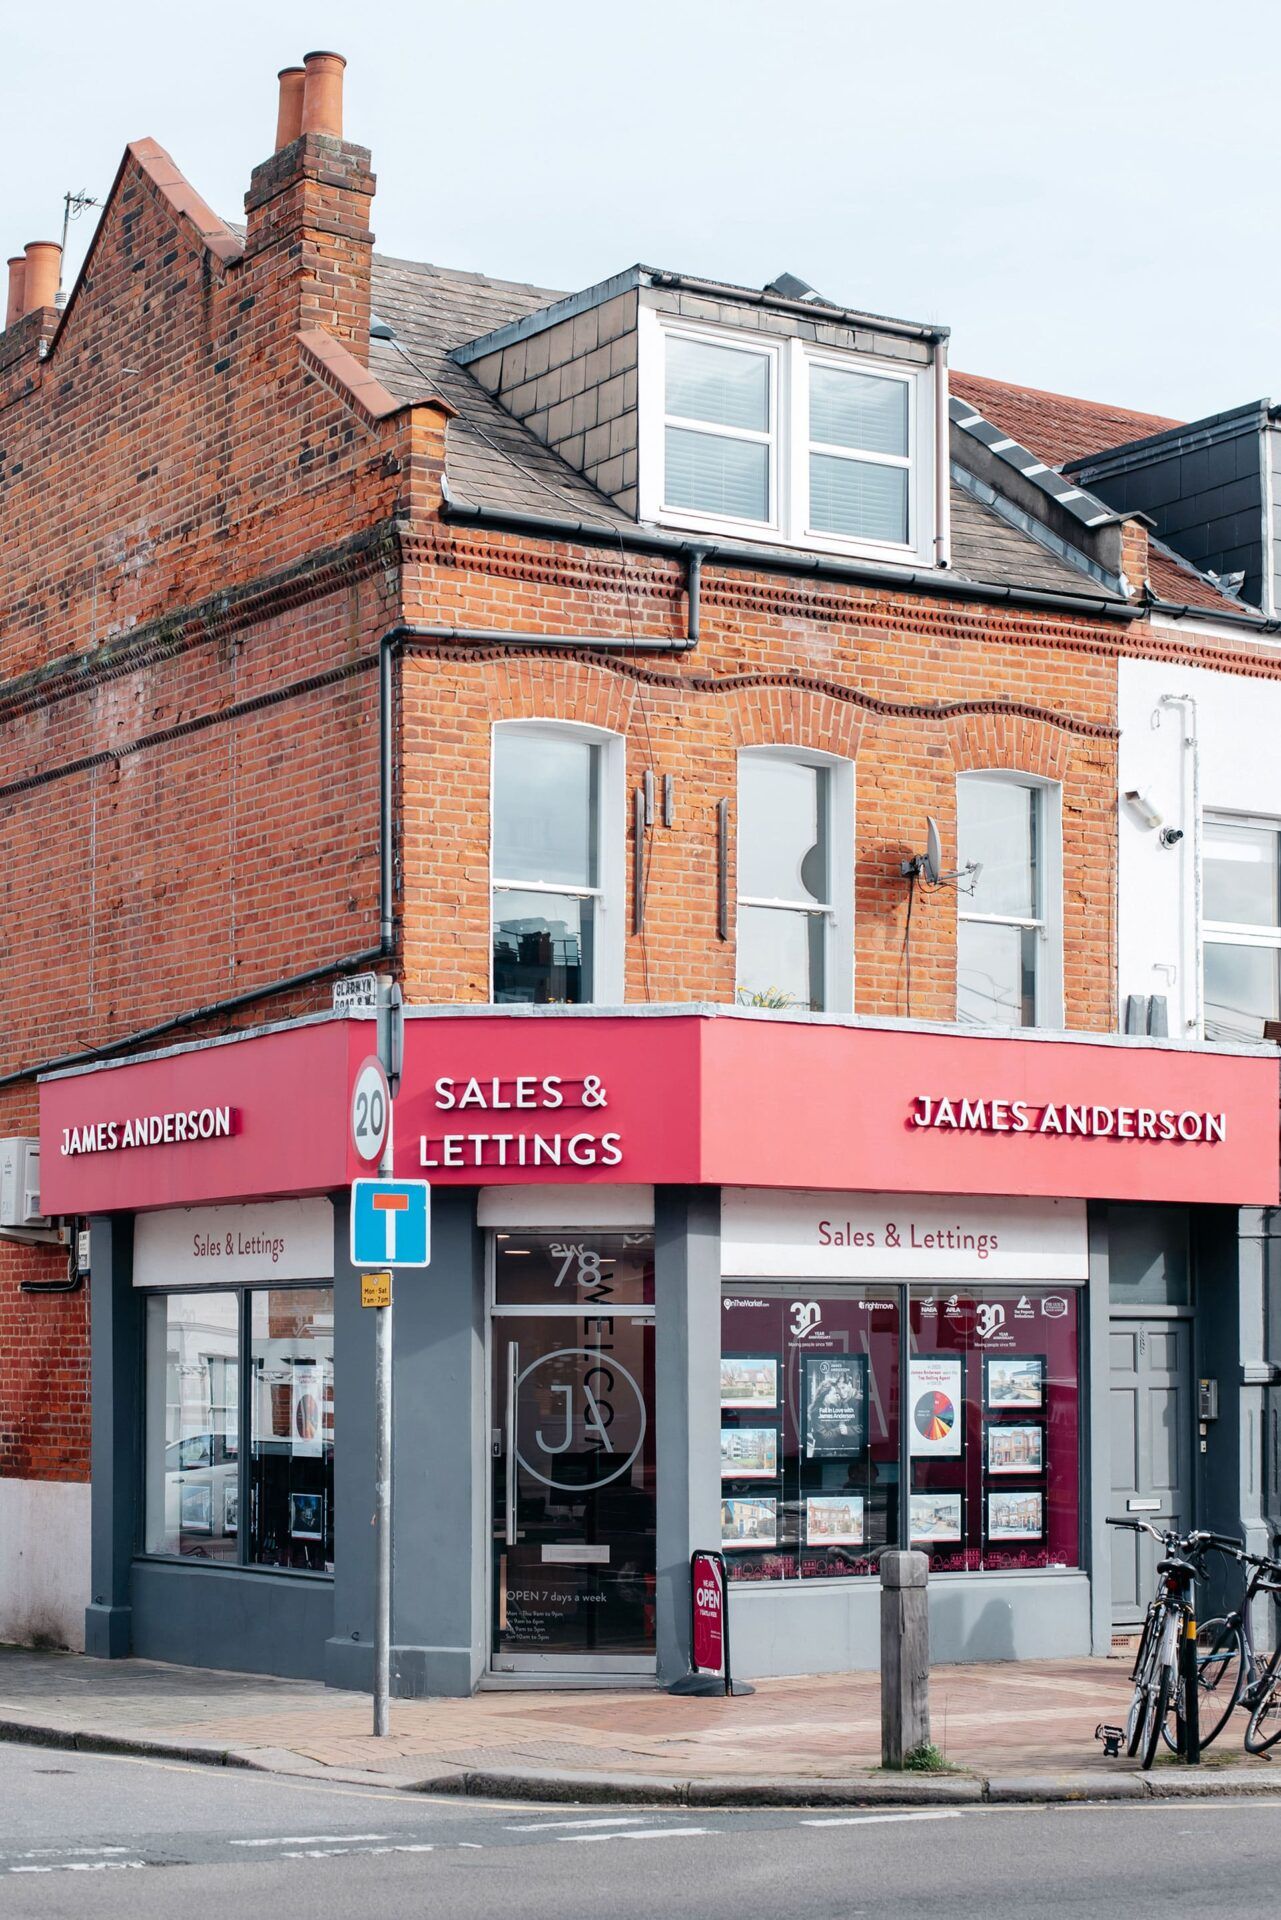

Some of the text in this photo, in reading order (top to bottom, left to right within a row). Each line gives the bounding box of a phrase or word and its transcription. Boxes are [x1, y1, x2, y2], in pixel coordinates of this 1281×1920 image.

[435, 1075, 608, 1110] SALES &
[356, 1089, 383, 1136] 20
[914, 1096, 1226, 1142] JAMES ANDERSON
[61, 1106, 230, 1155] JAMES ANDERSON
[419, 1133, 623, 1167] LETTINGS
[193, 1231, 284, 1263] Sales & Lettings
[818, 1221, 998, 1259] Sales & Lettings
[550, 1251, 602, 1288] 78
[790, 1302, 822, 1335] 30
[865, 1302, 894, 1311] rightmove
[976, 1304, 1005, 1336] 30
[583, 1272, 615, 1454] WELCO
[506, 1590, 607, 1605] OPEN 7 days a week
[697, 1588, 720, 1609] OPEN
